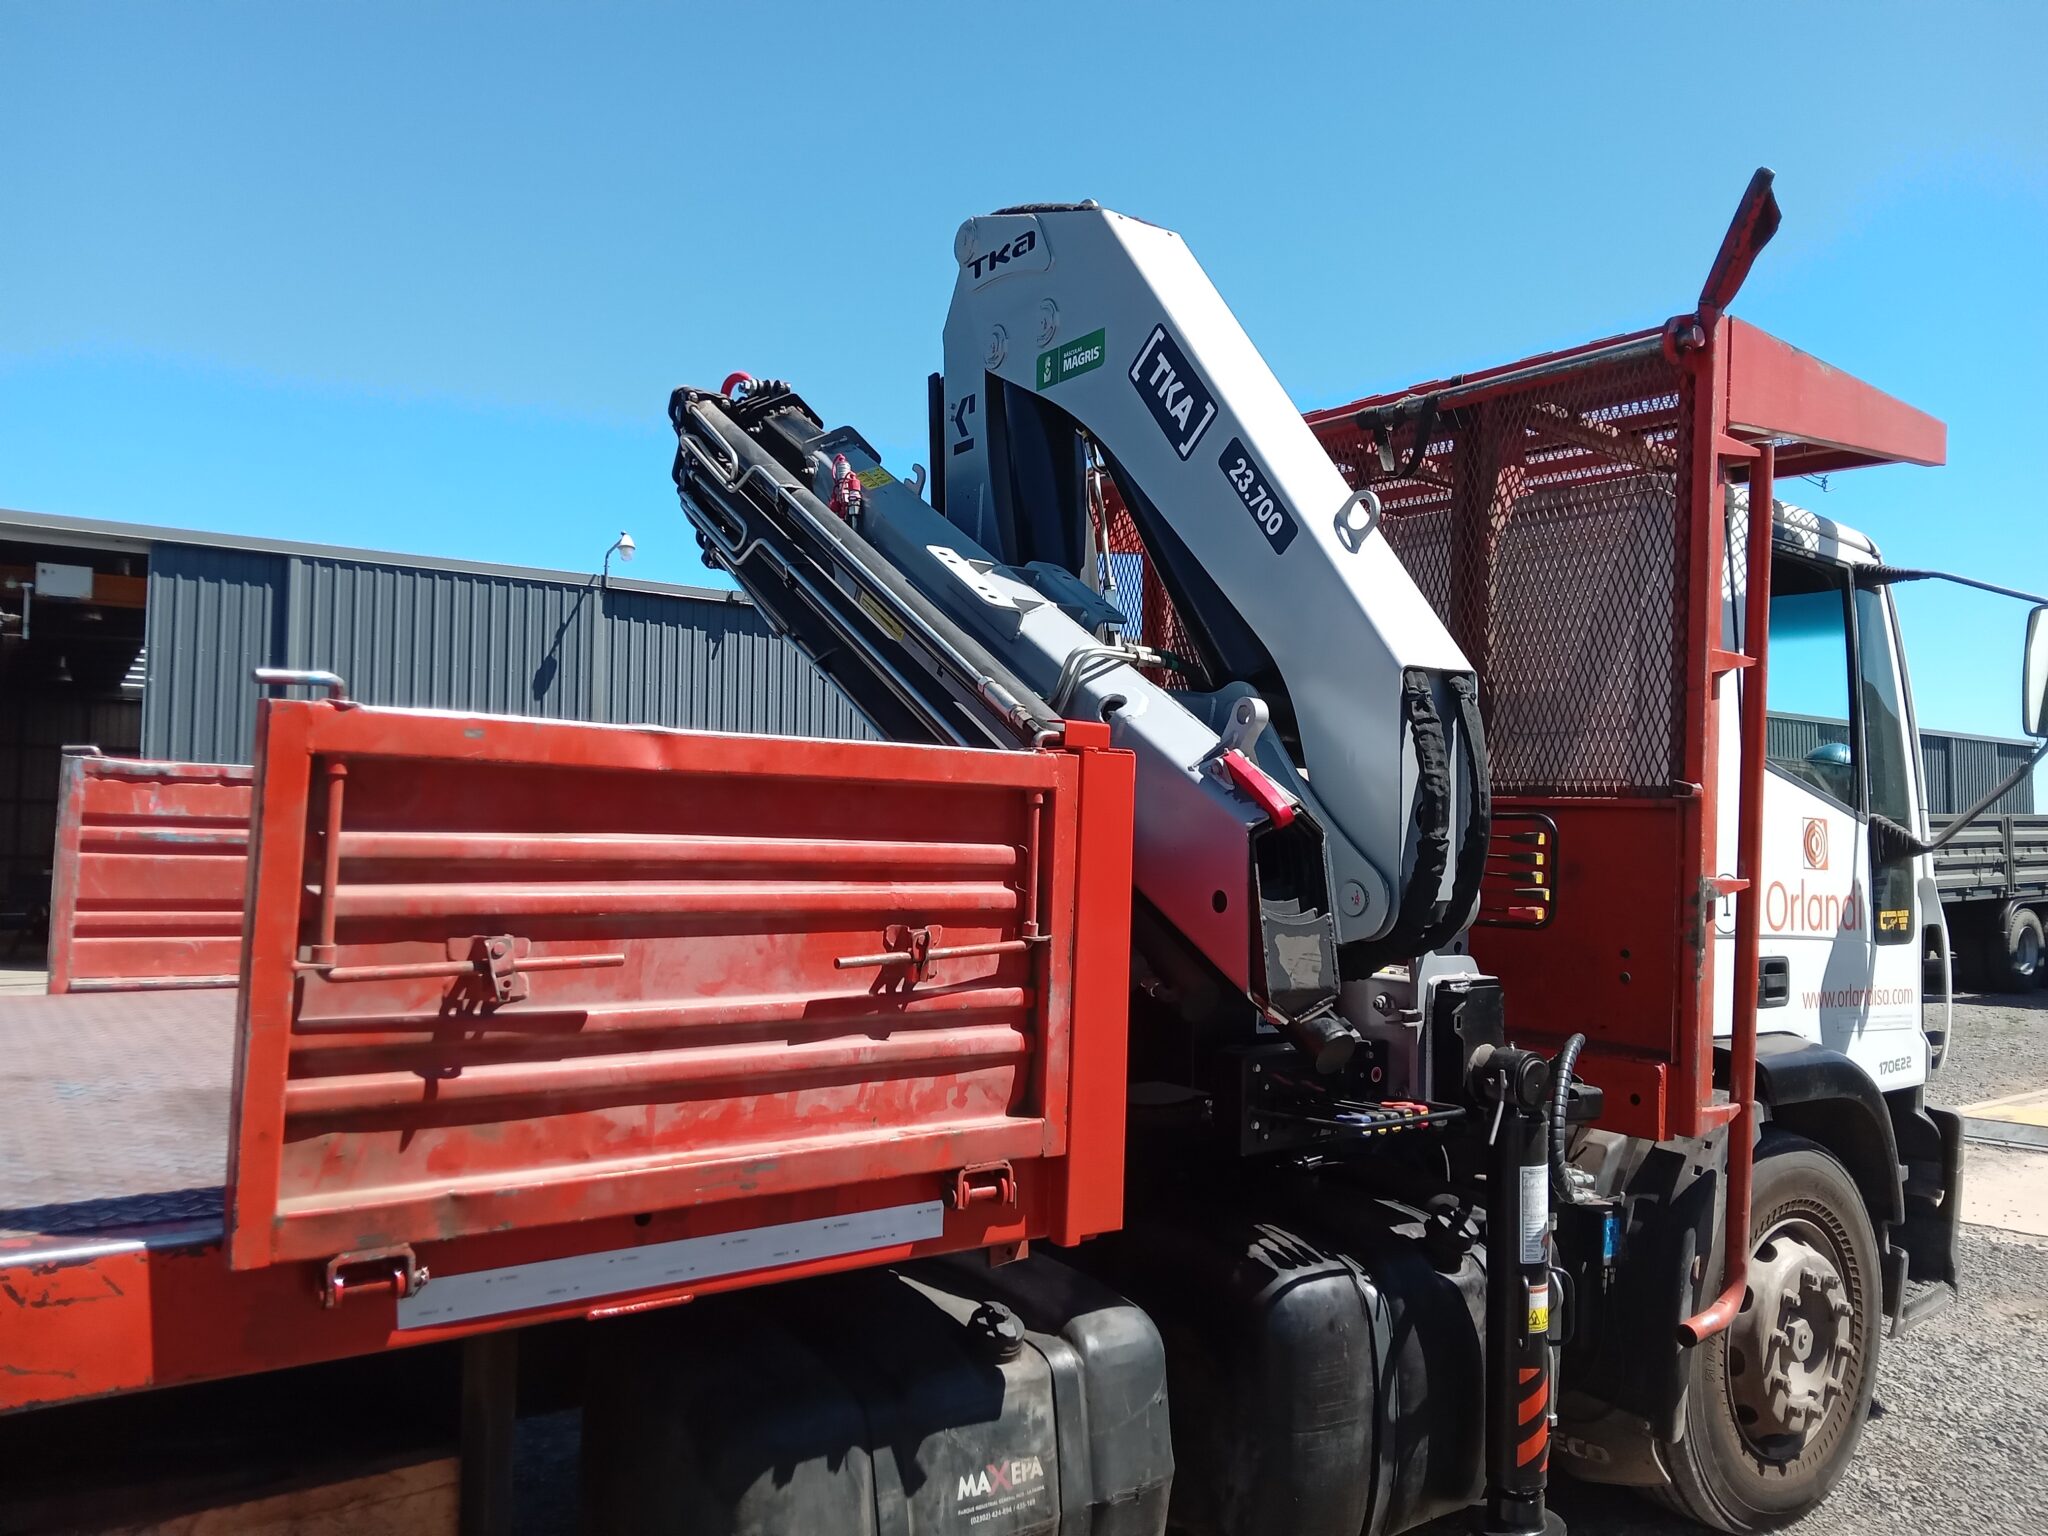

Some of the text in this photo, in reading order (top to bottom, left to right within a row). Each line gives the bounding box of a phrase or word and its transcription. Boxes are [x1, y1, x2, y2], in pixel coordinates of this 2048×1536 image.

[1063, 346, 1100, 373] MAGRIS
[1228, 457, 1283, 536] 23.700
[1766, 879, 1863, 932] Orlandi
[1802, 983, 1913, 1010] www.orlandisa.com
[1879, 1056, 1912, 1075] 170E22
